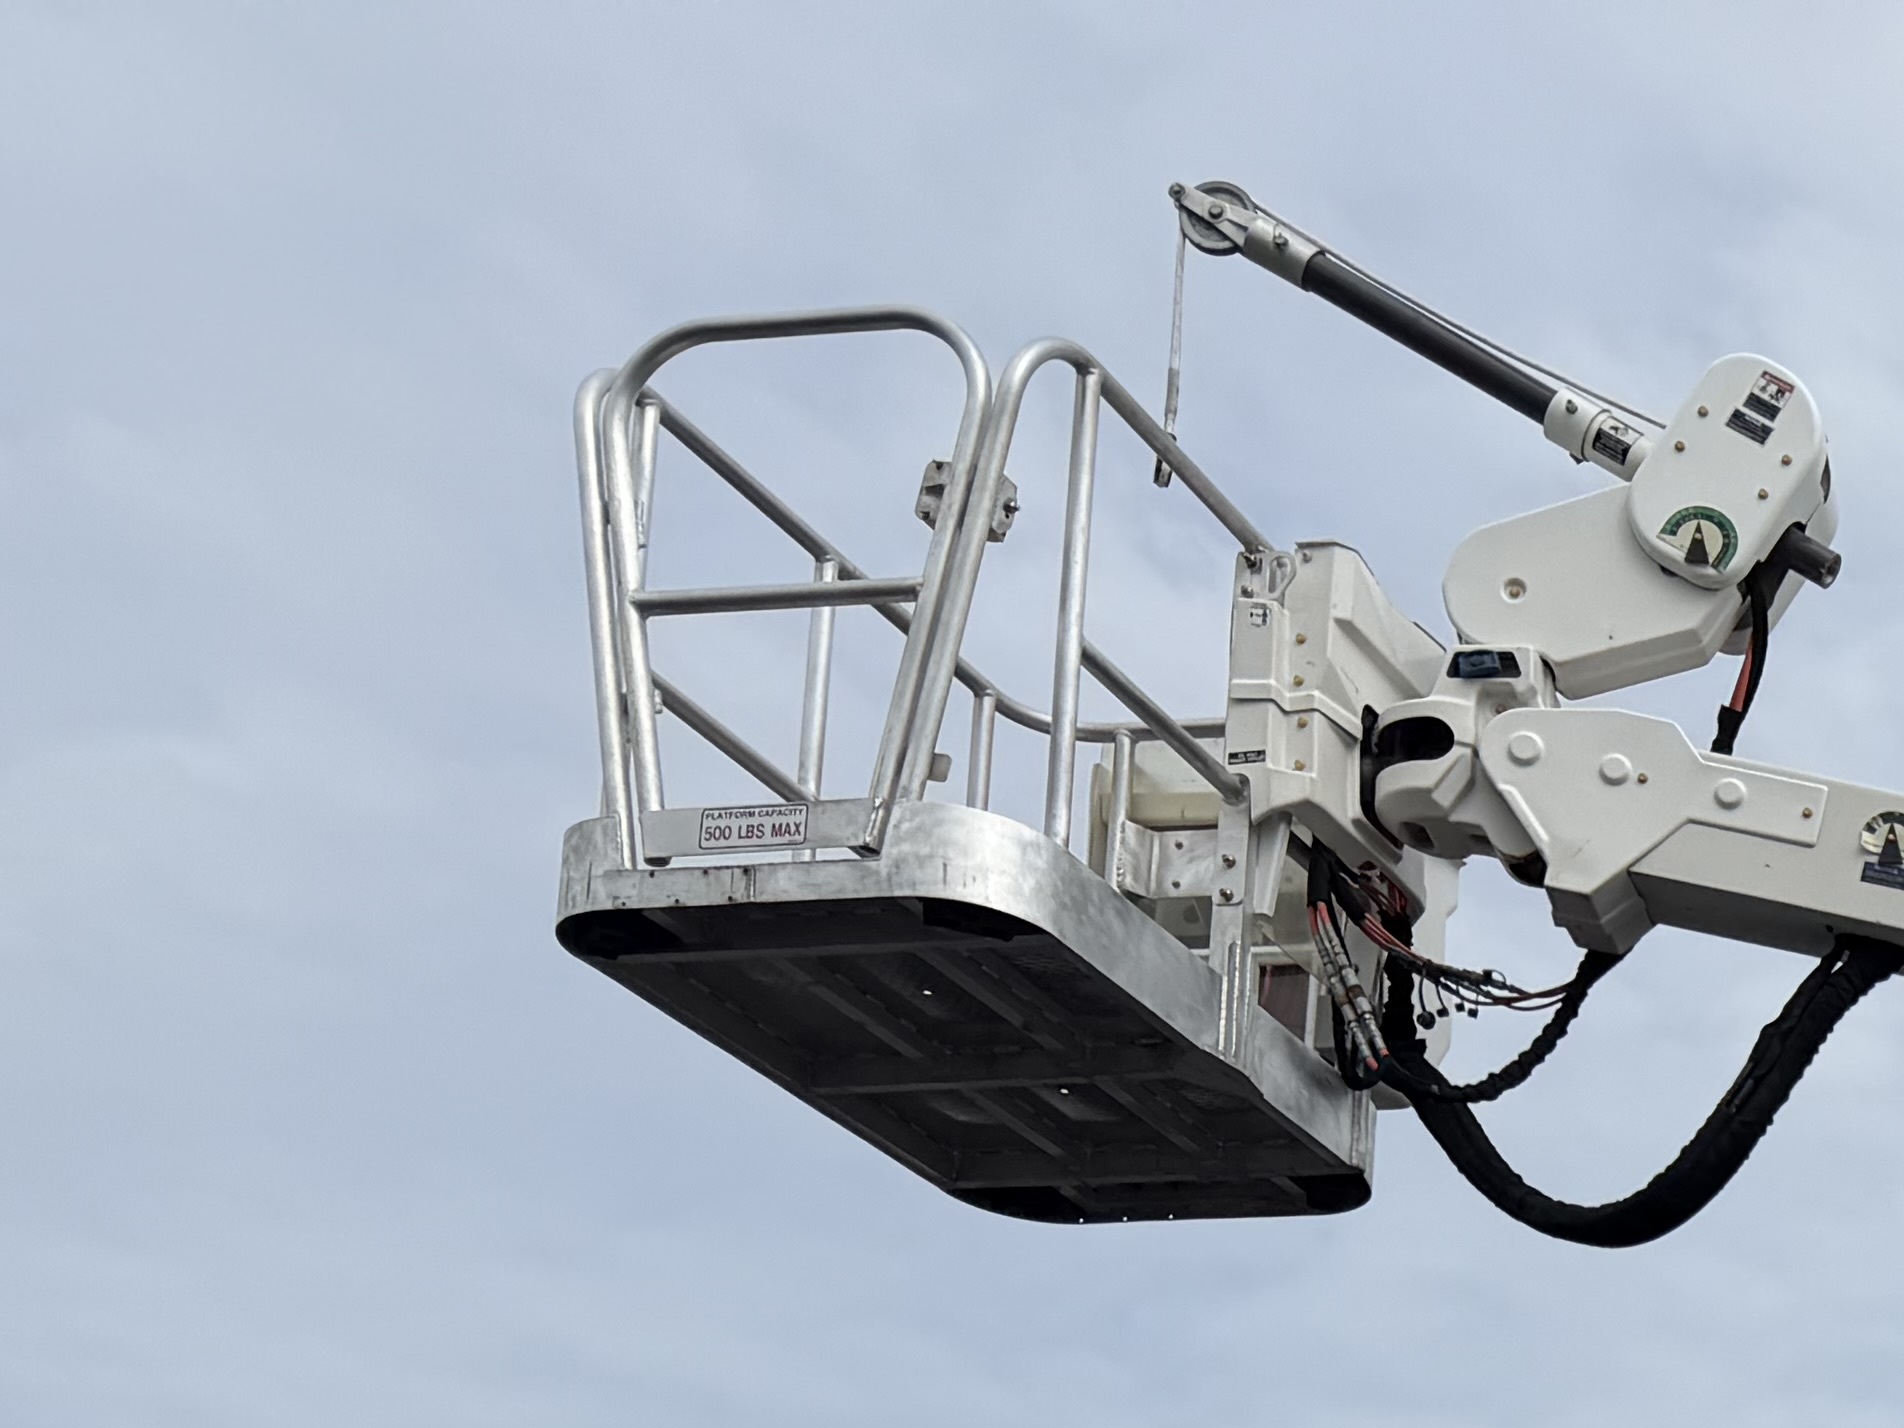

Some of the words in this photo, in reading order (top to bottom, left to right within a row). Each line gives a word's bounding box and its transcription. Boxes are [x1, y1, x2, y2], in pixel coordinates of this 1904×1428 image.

[705, 810, 756, 821] PLATFORM
[758, 808, 804, 818] CAPACITY
[703, 825, 733, 841] 500
[738, 823, 765, 840] LBS
[771, 821, 802, 838] MAX
